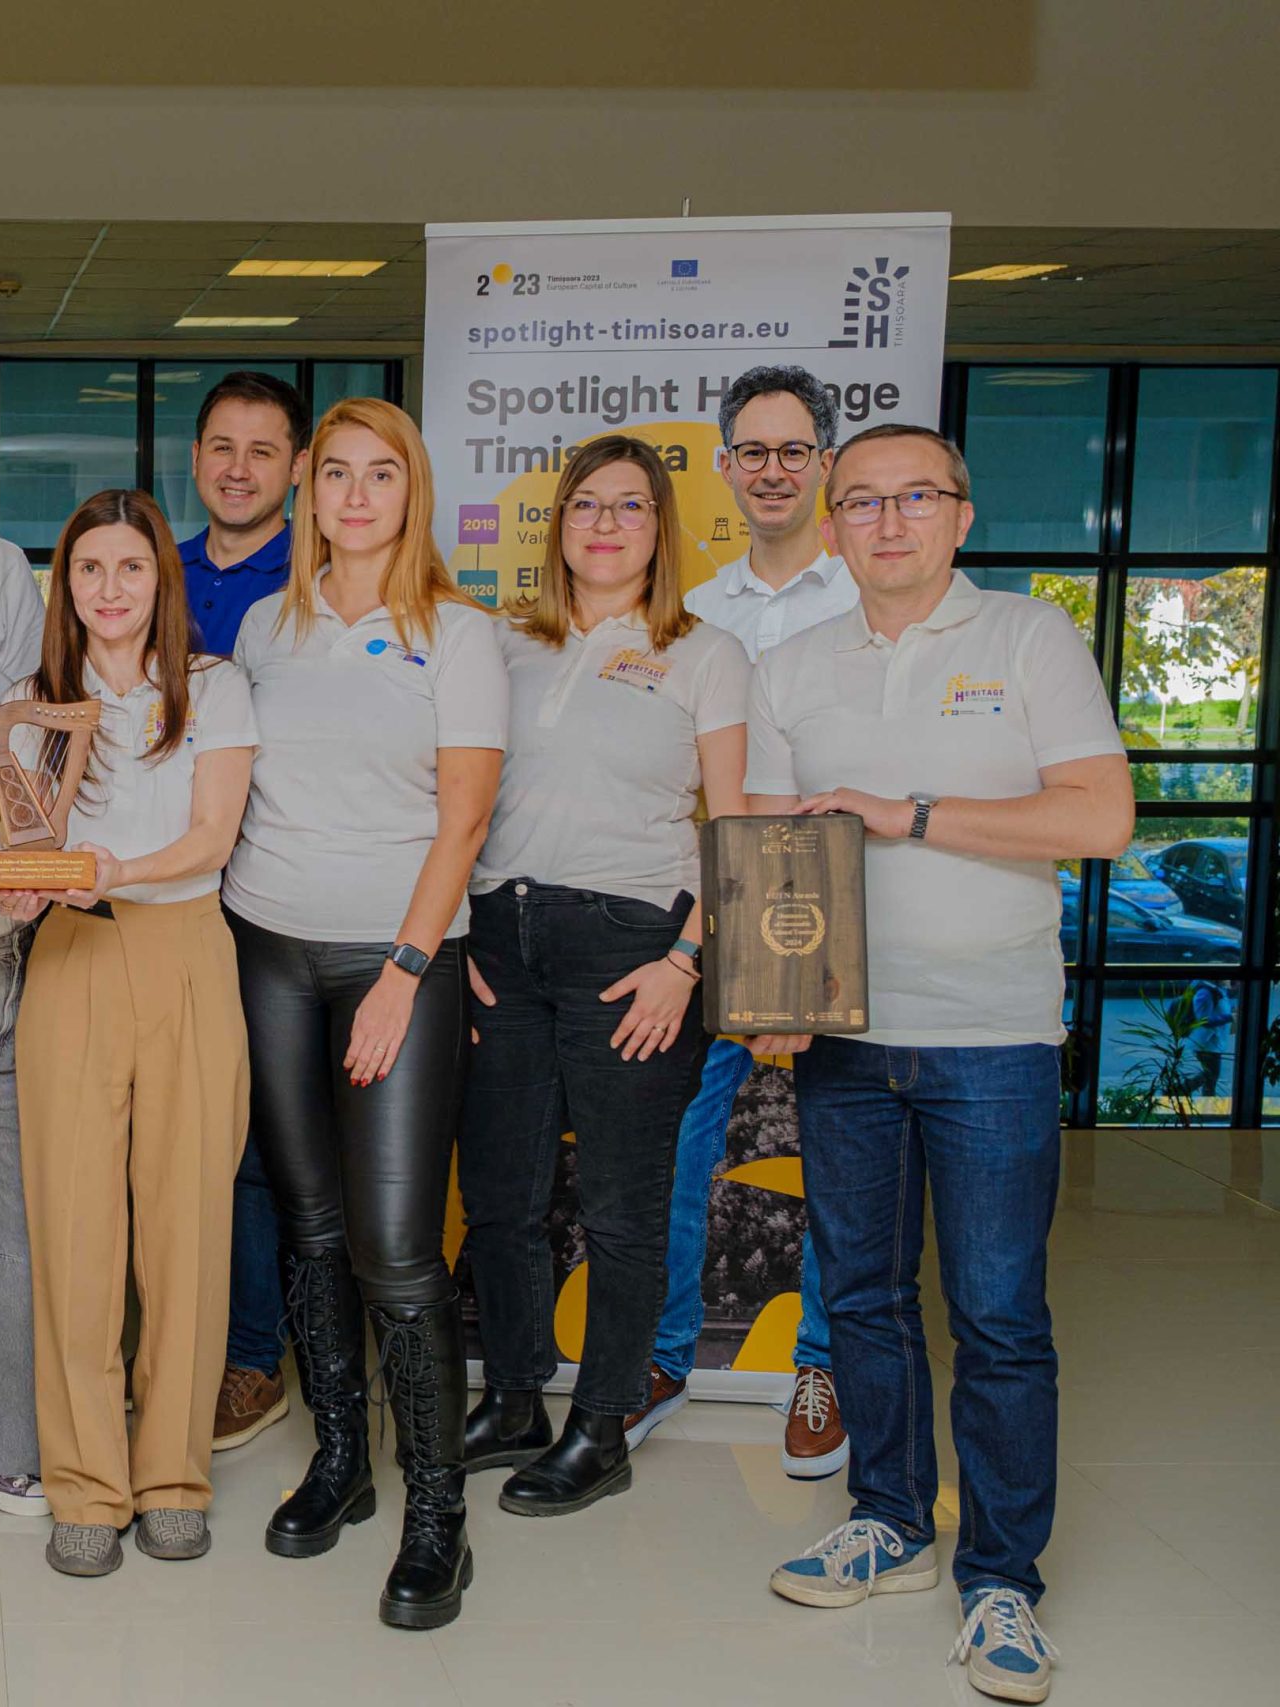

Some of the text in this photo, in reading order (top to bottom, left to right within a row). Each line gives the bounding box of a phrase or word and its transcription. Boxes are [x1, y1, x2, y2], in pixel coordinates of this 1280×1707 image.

[546, 283, 578, 291] European
[580, 282, 603, 290] Capital
[613, 281, 637, 289] Culture
[467, 318, 790, 348] spotlight-timisoara.eu
[466, 375, 679, 425] Spotlight
[463, 519, 497, 531] 2019
[460, 584, 496, 596] 2020
